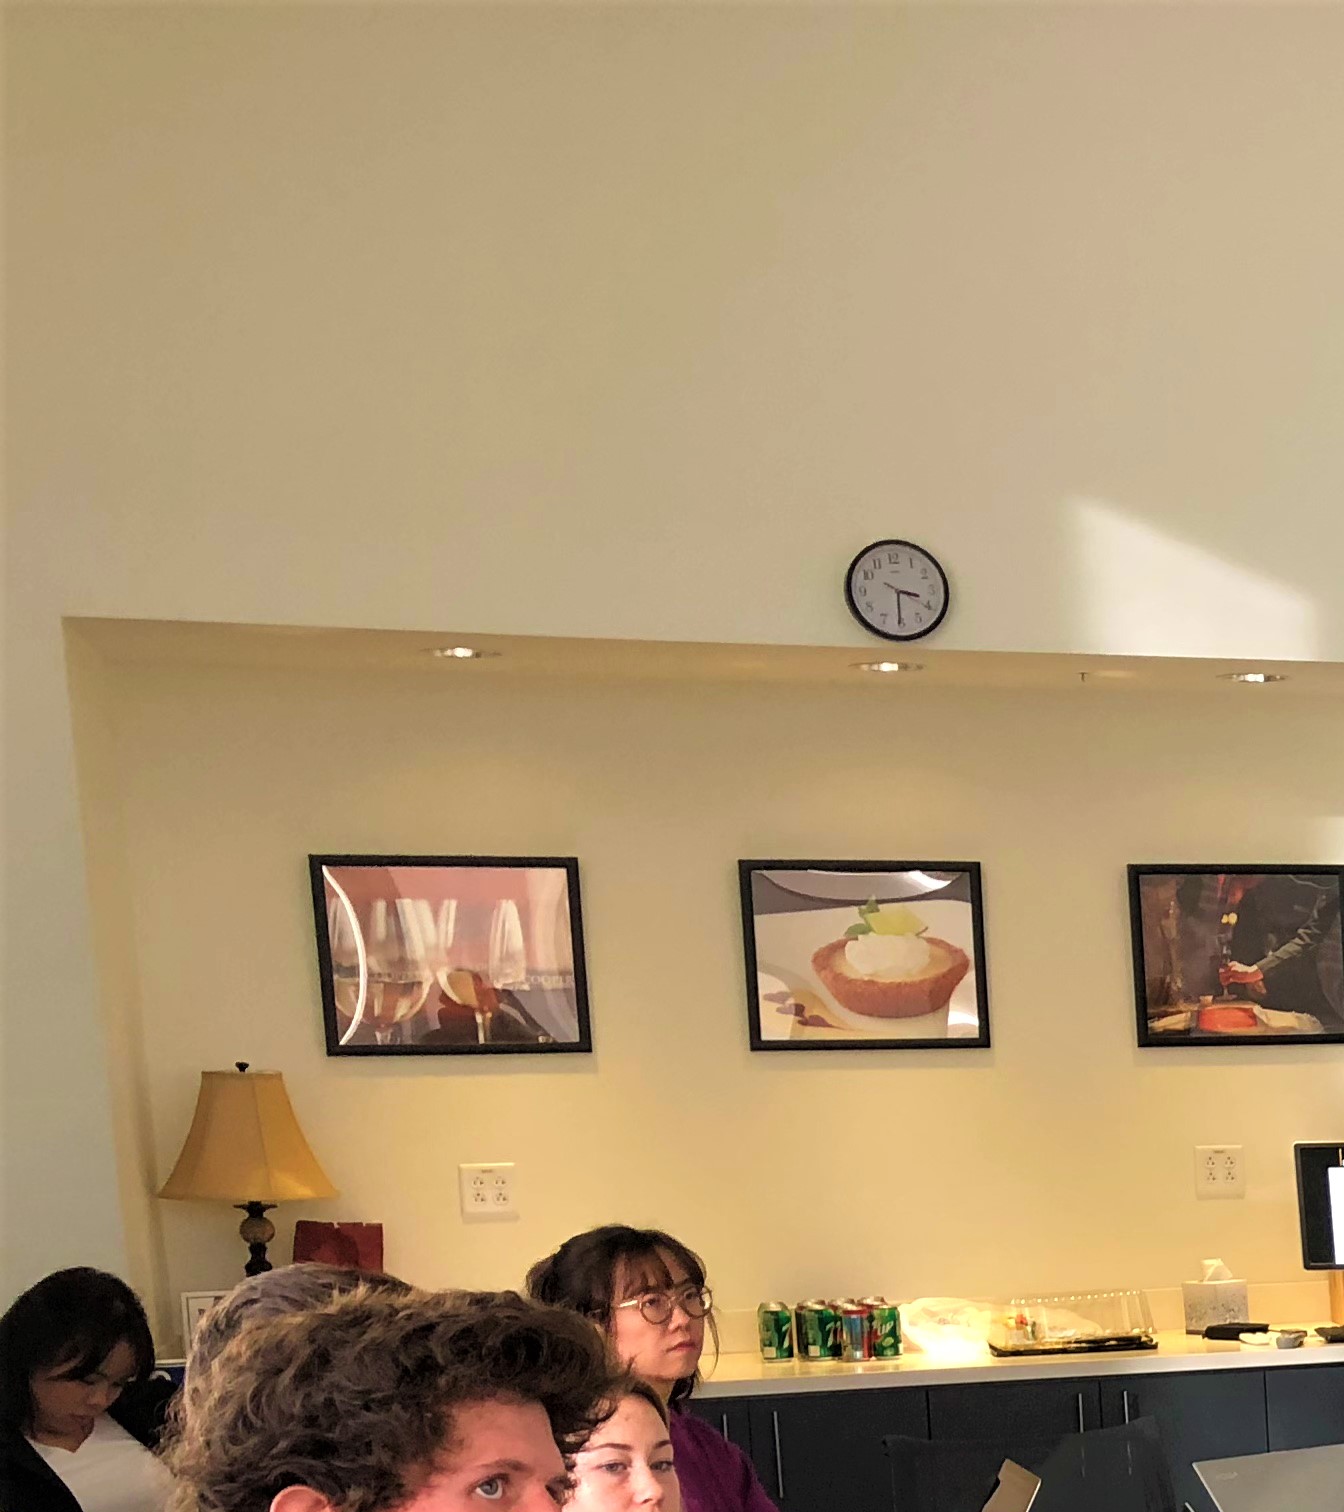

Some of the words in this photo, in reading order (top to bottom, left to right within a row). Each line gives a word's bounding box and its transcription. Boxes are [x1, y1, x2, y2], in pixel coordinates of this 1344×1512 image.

[872, 559, 882, 570] 11
[887, 552, 900, 565] 12
[863, 569, 875, 581] 10
[920, 568, 929, 580] 2
[859, 585, 867, 597] 9
[927, 584, 936, 596] 3
[865, 601, 874, 613] 8
[921, 600, 932, 611] 4
[880, 613, 888, 625] 7
[914, 612, 923, 624] 5
